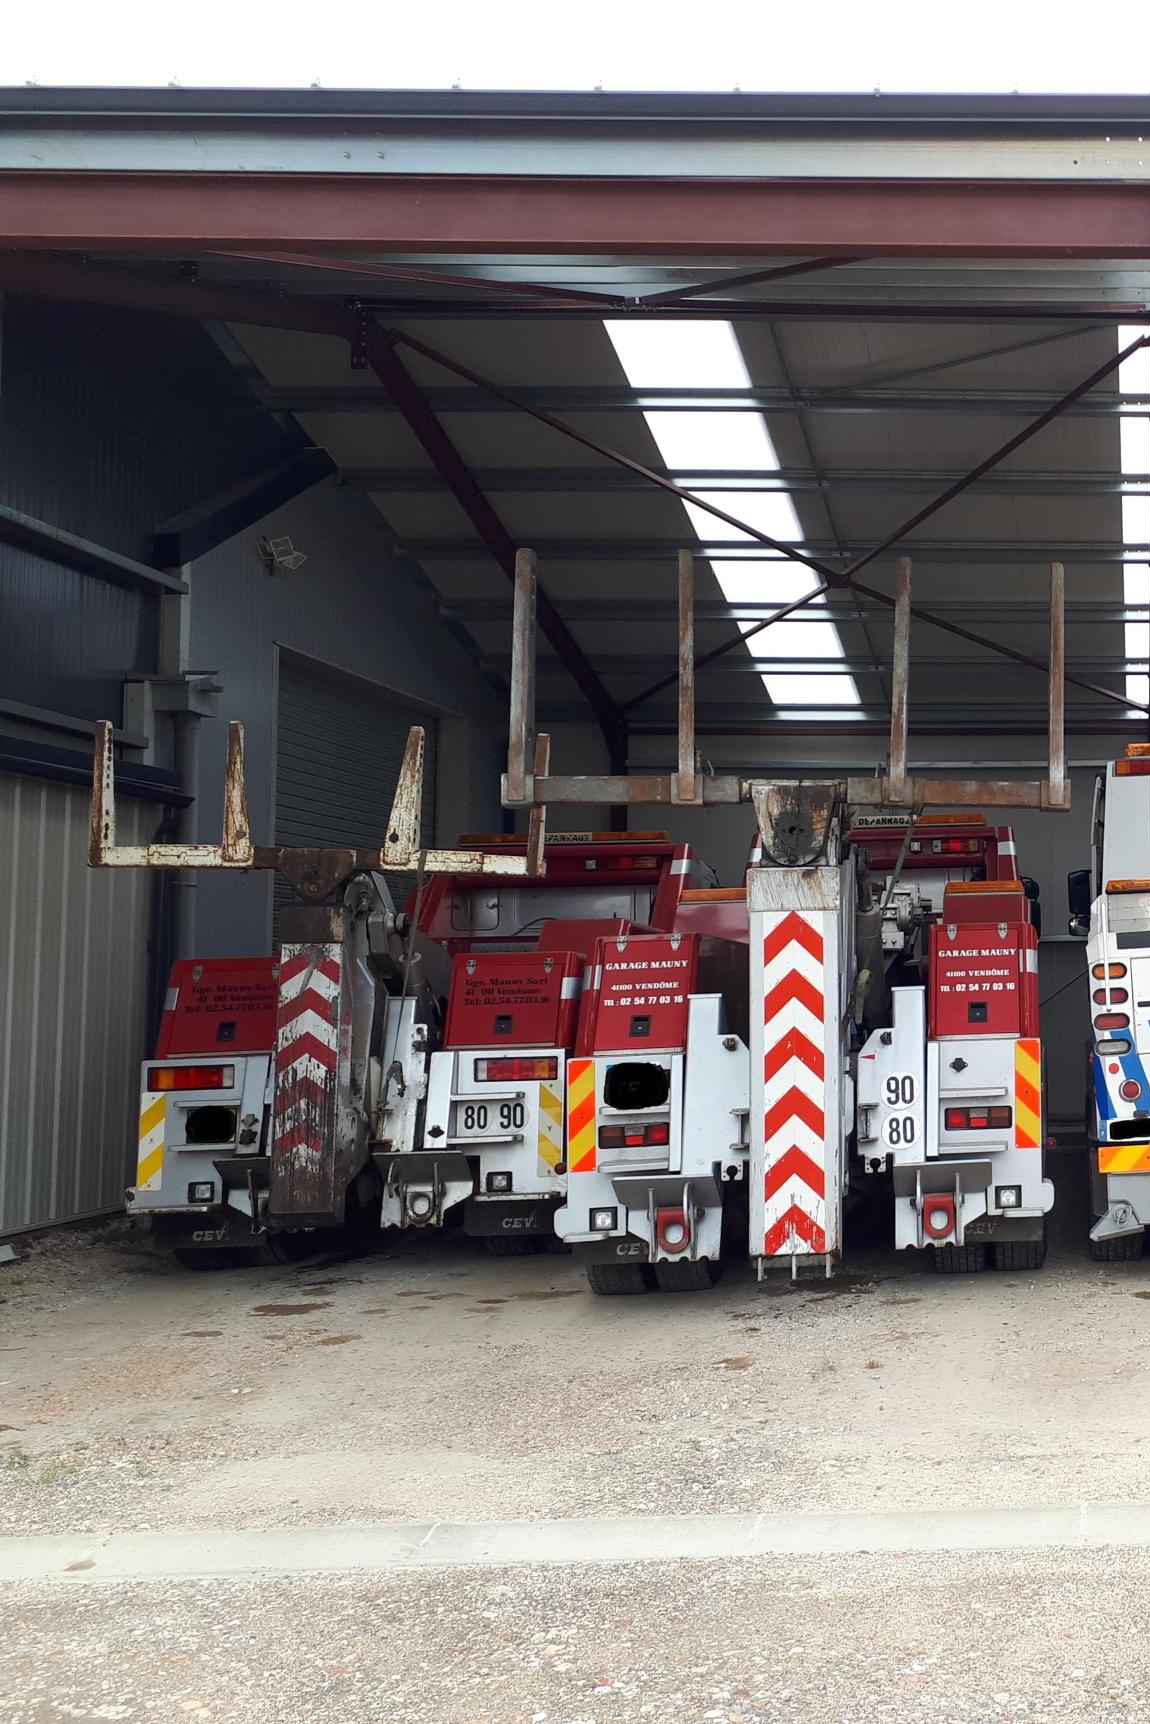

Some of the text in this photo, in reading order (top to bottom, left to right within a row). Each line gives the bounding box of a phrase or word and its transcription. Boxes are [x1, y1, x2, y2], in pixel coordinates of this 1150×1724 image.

[938, 948, 1016, 957] GARAGE MAUNY
[605, 960, 688, 971] GARAGE MAUNY
[955, 983, 967, 992] 02
[968, 983, 980, 991] 54
[982, 983, 991, 991] 77
[992, 982, 1003, 991] 03
[1006, 982, 1015, 990] 16
[620, 997, 631, 1006] 02
[634, 997, 645, 1005] 54
[648, 996, 657, 1004] 77
[659, 996, 671, 1004] 03
[674, 995, 684, 1003] 16
[886, 1075, 915, 1106] 90
[464, 1104, 488, 1130] 80
[499, 1102, 525, 1130] 90
[888, 1116, 915, 1145] 80
